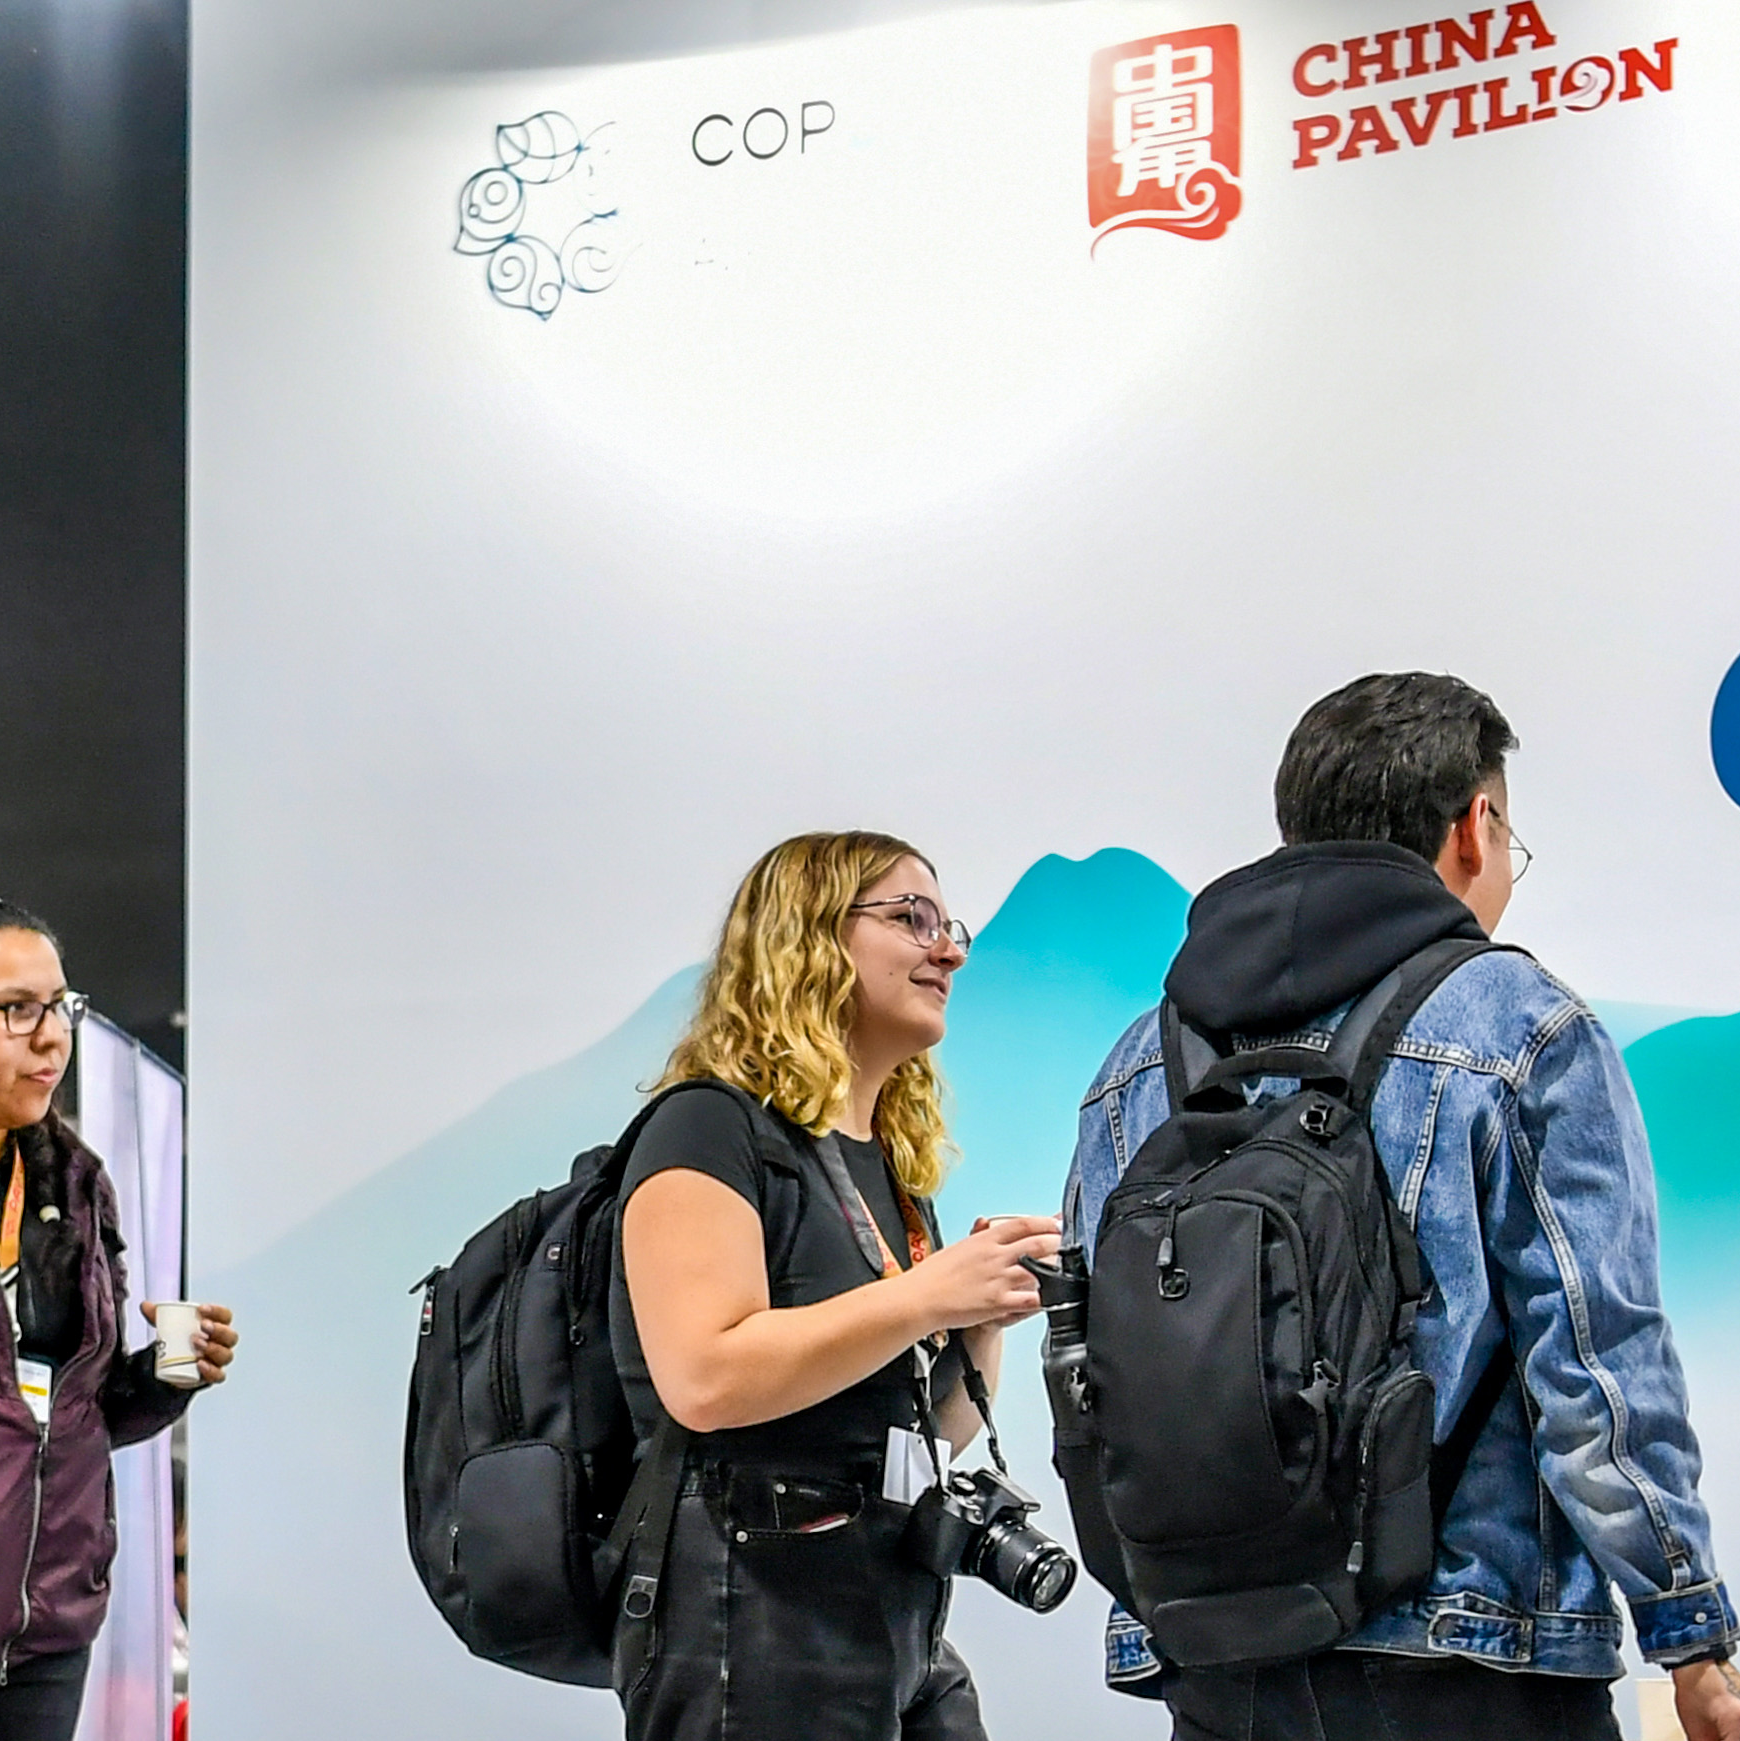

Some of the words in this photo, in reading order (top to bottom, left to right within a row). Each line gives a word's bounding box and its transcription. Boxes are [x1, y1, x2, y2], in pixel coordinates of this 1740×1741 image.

[1292, 0, 1557, 98] CHINA
[691, 100, 836, 167] COP
[1292, 38, 1680, 170] PAVILION
